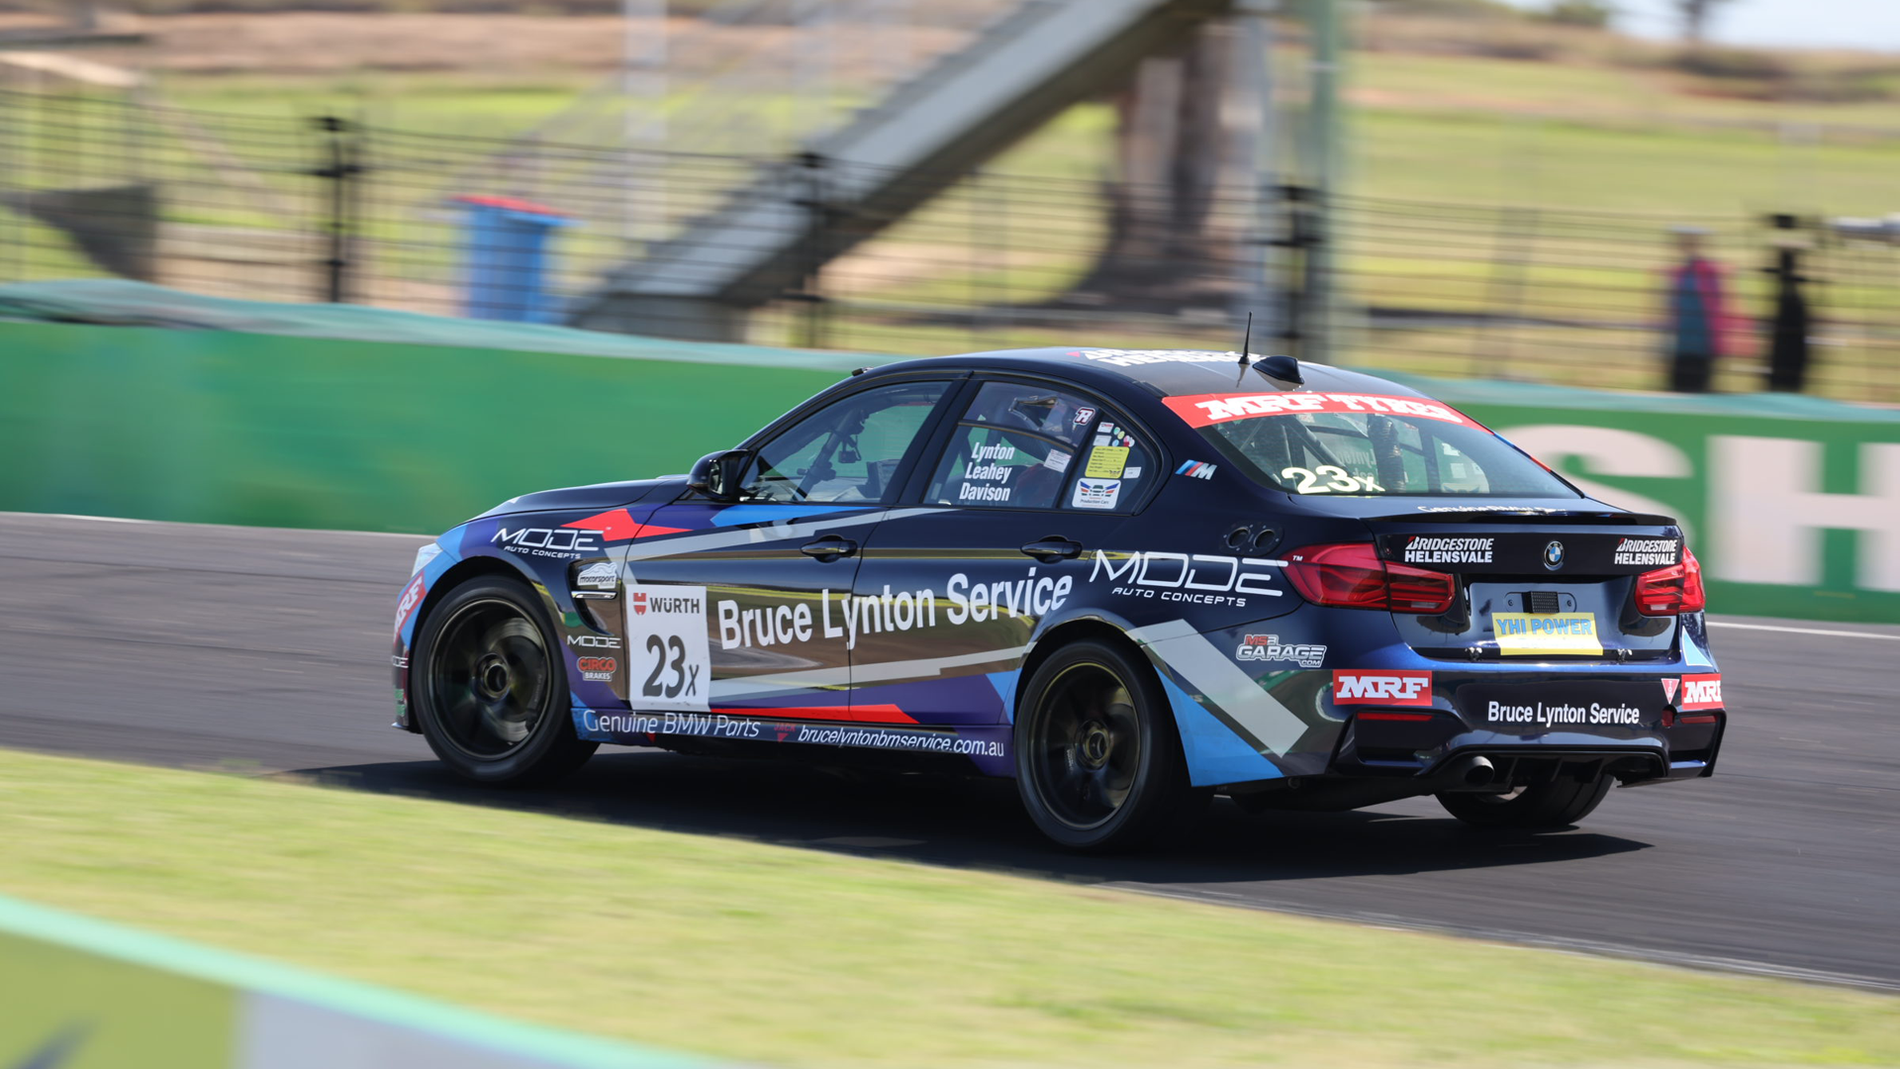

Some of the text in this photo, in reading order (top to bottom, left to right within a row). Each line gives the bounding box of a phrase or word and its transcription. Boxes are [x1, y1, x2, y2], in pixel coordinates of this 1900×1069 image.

[1195, 394, 1463, 423] MRF TYRES
[971, 442, 1015, 462] Lynton
[965, 462, 1012, 484] Leahey
[959, 482, 1011, 501] Davison
[491, 528, 604, 551] MODE
[1405, 536, 1494, 551] BRIDGESTONE
[1616, 538, 1677, 553] BRIDGESTONE
[504, 545, 581, 559] AUTO CONCEPTS
[1404, 551, 1493, 563] HELENSVALE
[1614, 553, 1676, 565] HELENSVALE
[1089, 549, 1289, 597] MODE
[1112, 587, 1246, 607] AUTO CONCEPTS
[717, 567, 1073, 650] Bruce Lynton Service
[1496, 618, 1593, 635] YHI POWER
[567, 635, 621, 649] MODE
[1238, 645, 1325, 660] GARAGE
[578, 658, 616, 671] CIRCO
[585, 672, 611, 681] BRAKES
[1336, 676, 1429, 699] MRF
[583, 709, 761, 737] Genuine BMW Parts
[1488, 701, 1640, 728] Bruce Lynton Service
[798, 725, 1004, 757] brucelyntonbmservice.com.au
